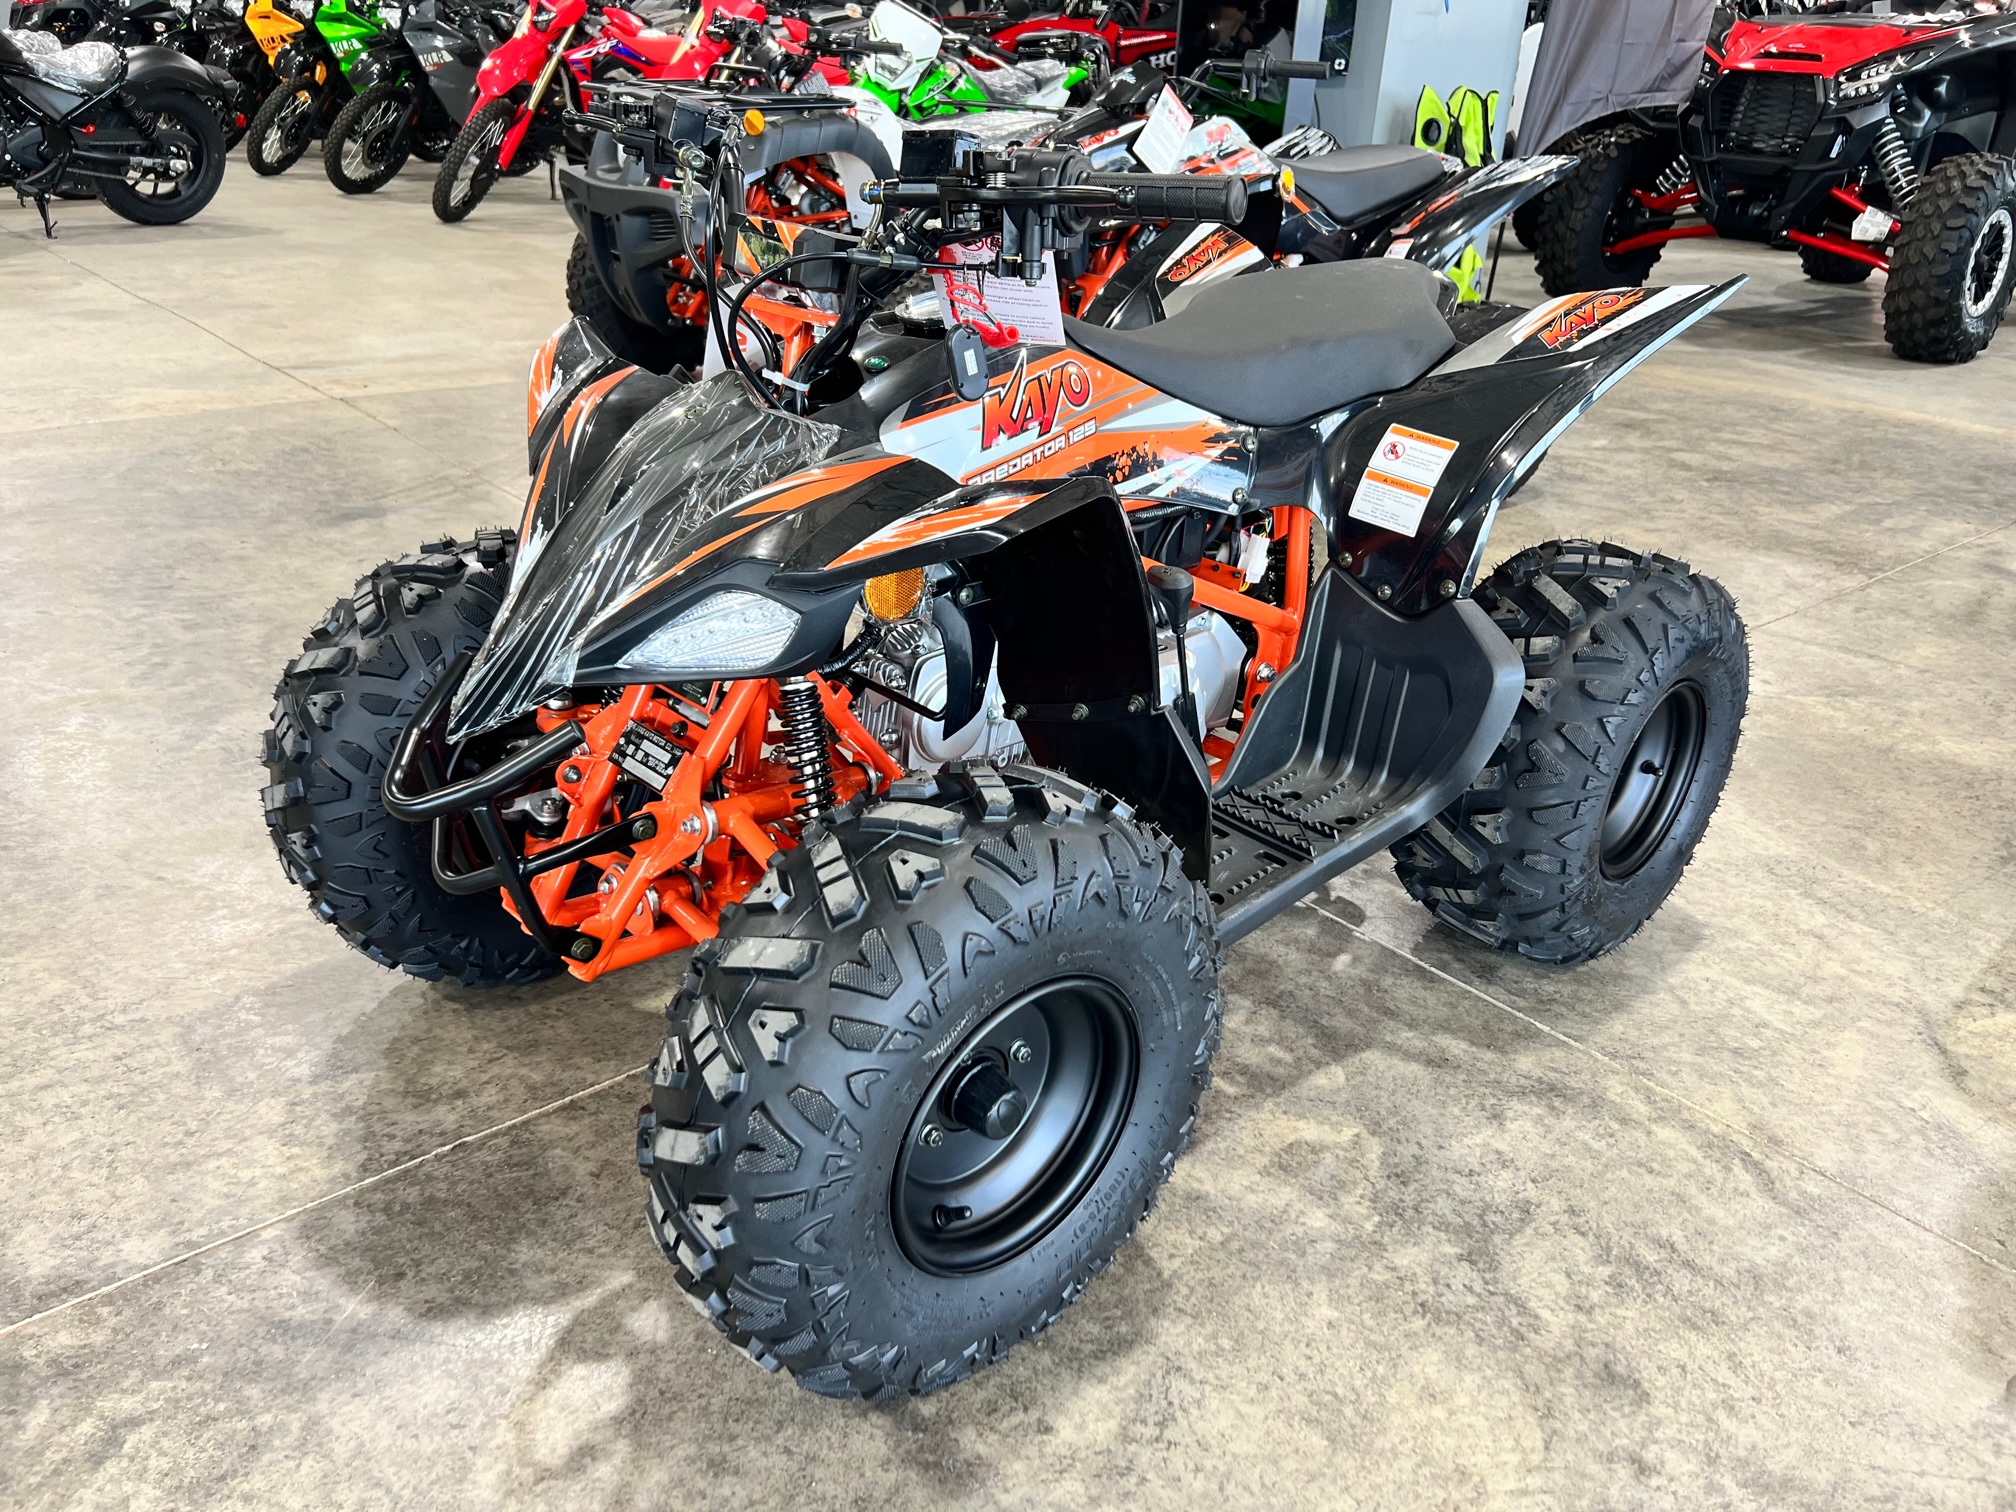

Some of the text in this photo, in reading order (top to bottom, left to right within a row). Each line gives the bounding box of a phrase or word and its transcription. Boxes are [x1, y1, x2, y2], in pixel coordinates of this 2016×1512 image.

[333, 38, 356, 54] KLR
[422, 51, 447, 67] KLR
[1168, 239, 1229, 282] KAYO
[1537, 294, 1623, 350] KAYO
[981, 348, 1093, 453] KAYO
[1067, 416, 1098, 448] 125
